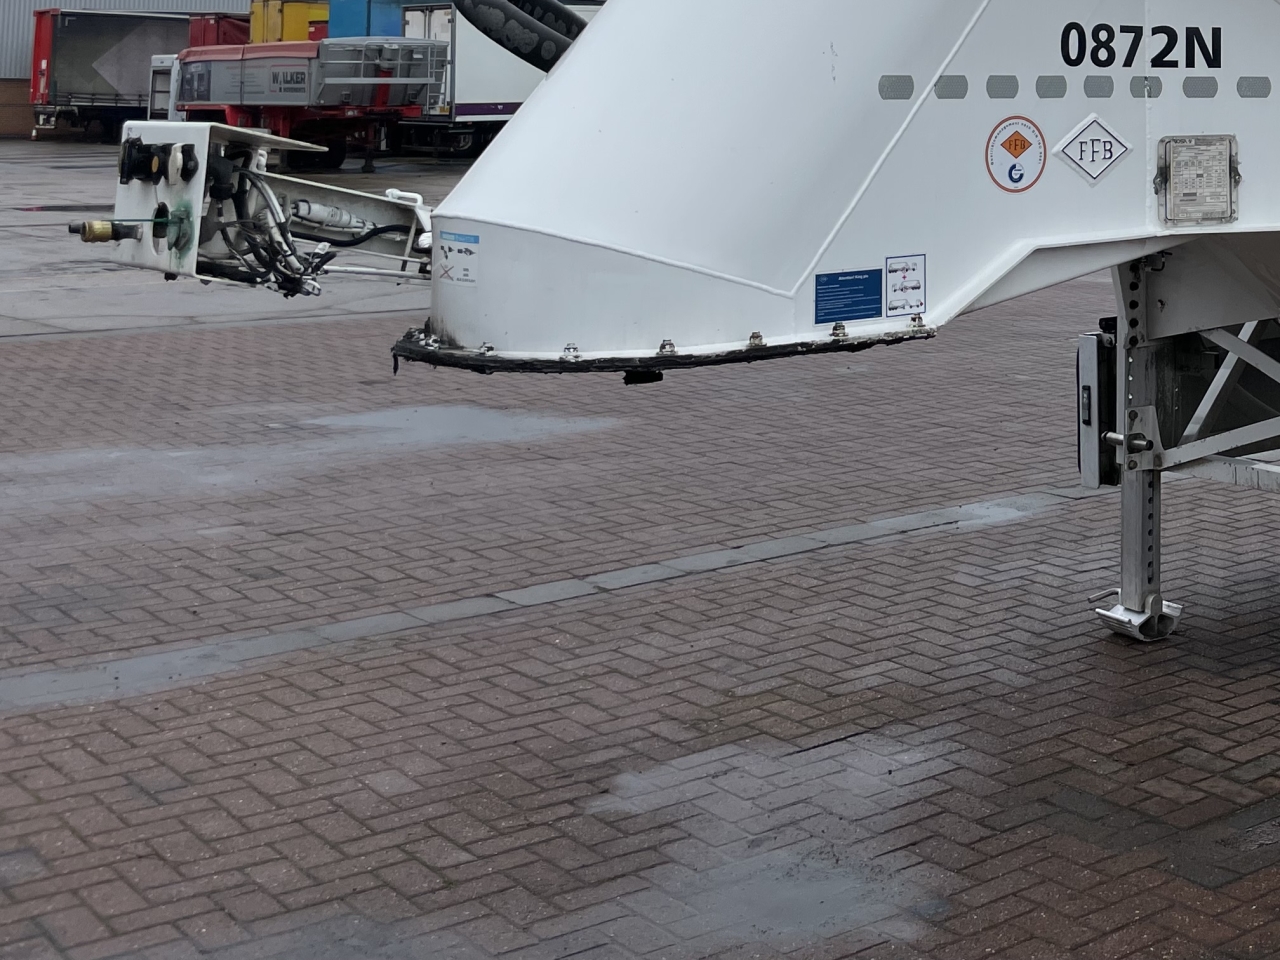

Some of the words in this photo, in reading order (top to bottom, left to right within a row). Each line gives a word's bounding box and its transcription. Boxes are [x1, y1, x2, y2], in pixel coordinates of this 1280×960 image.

[1060, 20, 1222, 69] 0872N
[1008, 138, 1026, 151] FFB
[1078, 138, 1114, 163] FFB
